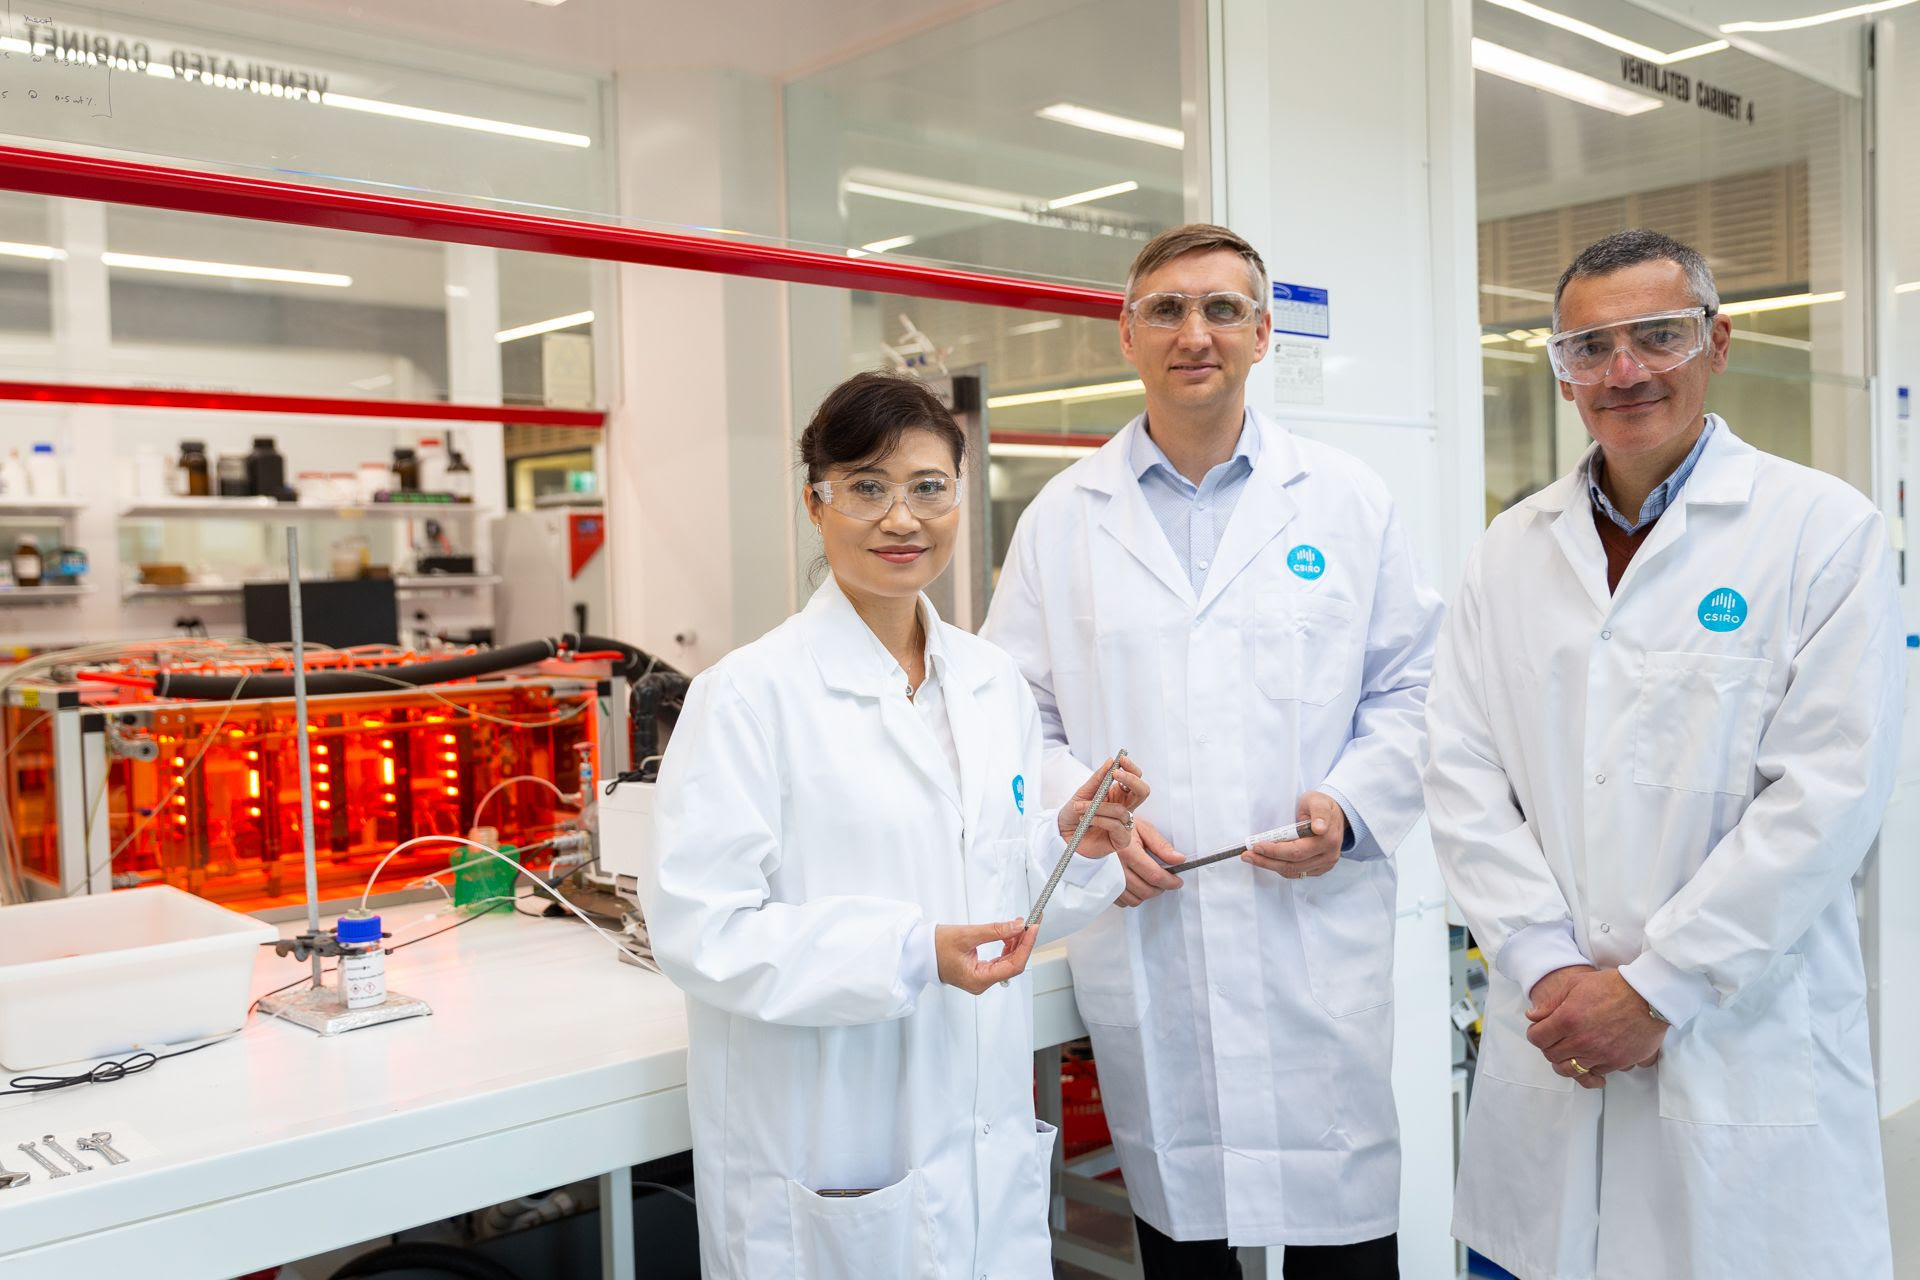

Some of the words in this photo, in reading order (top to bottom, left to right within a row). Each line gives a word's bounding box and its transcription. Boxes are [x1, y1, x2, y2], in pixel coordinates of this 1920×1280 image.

[1621, 56, 1691, 103] VENTILATED
[1696, 80, 1742, 121] CABINET
[1746, 101, 1755, 125] 4
[1294, 564, 1320, 573] CSIRO
[1704, 613, 1740, 624] CSIRO
